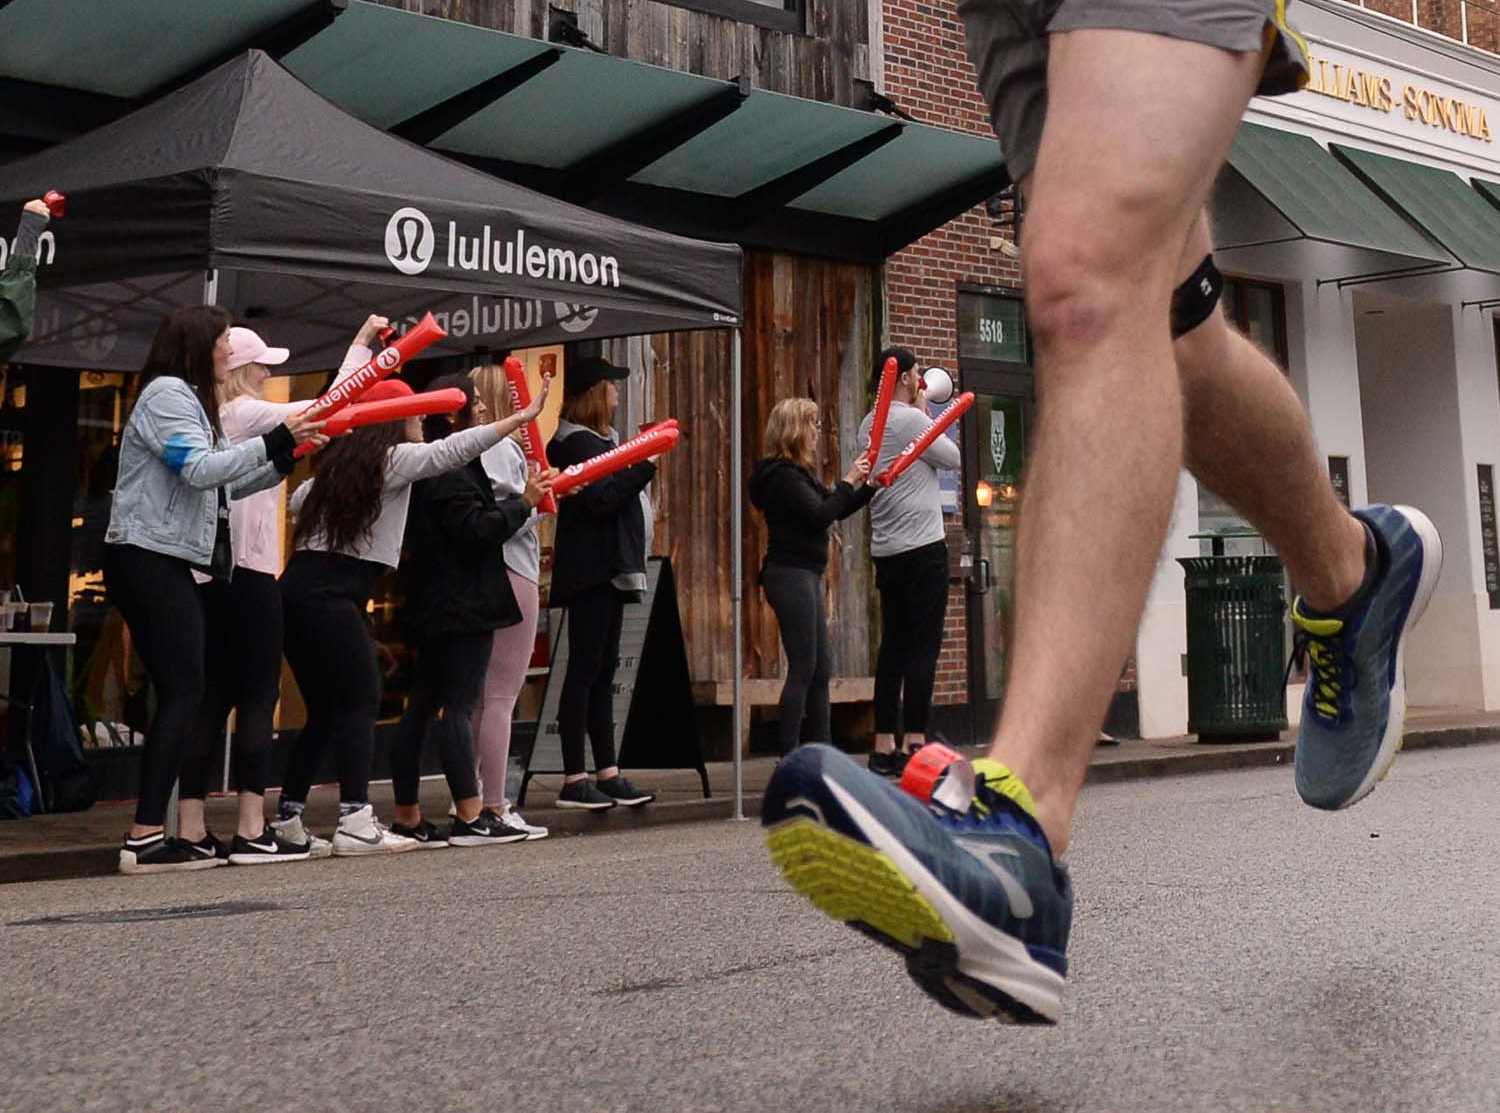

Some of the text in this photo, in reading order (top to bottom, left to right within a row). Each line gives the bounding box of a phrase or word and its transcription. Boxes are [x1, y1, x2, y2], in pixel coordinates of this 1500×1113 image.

[1306, 55, 1493, 143] LLIAMS-SONOMA
[447, 221, 620, 287] lululemon
[979, 318, 1003, 344] 5518
